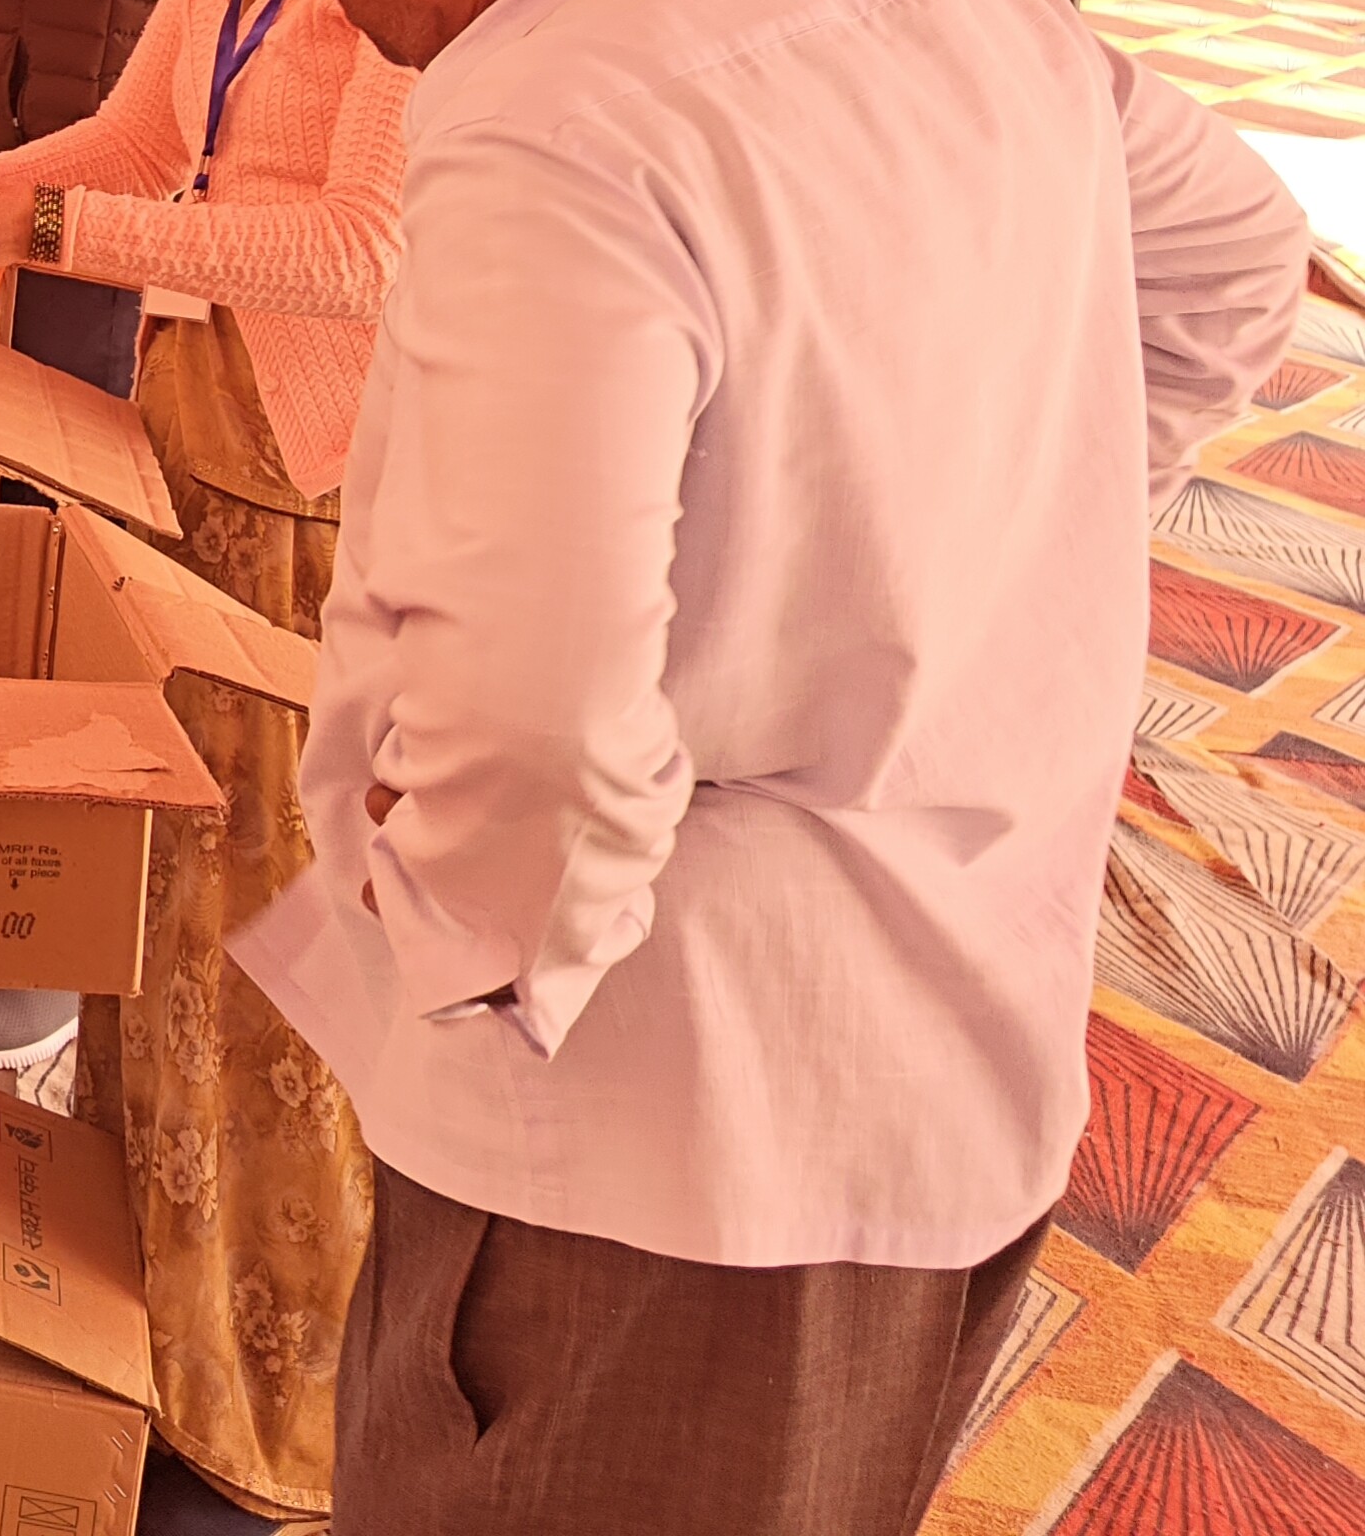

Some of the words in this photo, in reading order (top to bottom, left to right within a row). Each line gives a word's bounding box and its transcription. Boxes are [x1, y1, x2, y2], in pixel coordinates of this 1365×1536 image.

[38, 845, 62, 856] Rs.
[1, 856, 12, 865] of
[30, 868, 61, 879] piece
